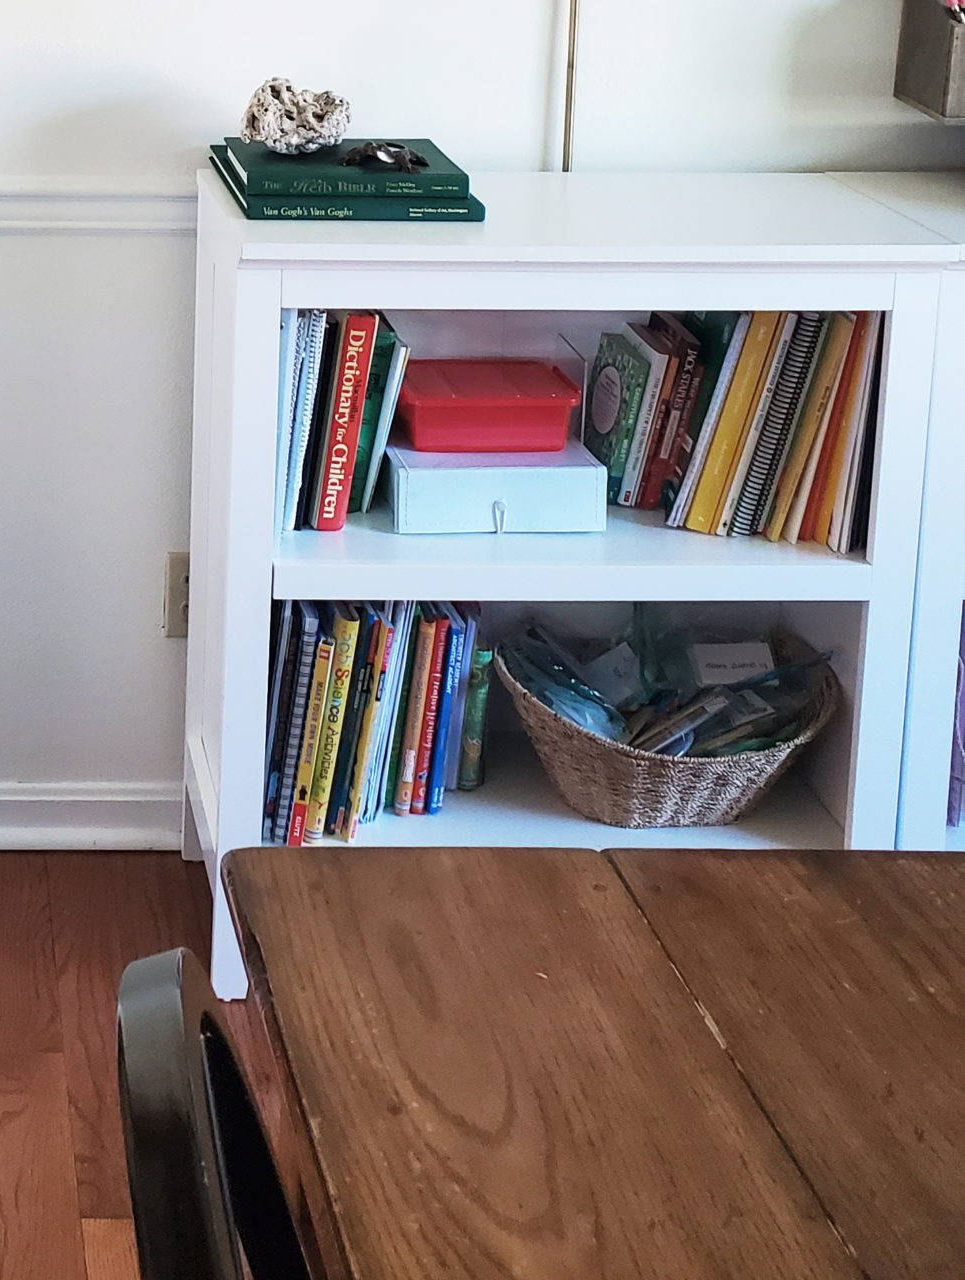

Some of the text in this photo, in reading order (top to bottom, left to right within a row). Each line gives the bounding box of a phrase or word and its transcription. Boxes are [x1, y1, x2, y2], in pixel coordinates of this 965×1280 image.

[263, 206, 278, 216] Van
[280, 206, 308, 218] Gogh's
[310, 207, 325, 216] Van
[683, 348, 698, 372] JACK
[674, 372, 690, 409] STAPLES
[323, 329, 366, 519] Dictionary for Children
[328, 667, 350, 724] Science
